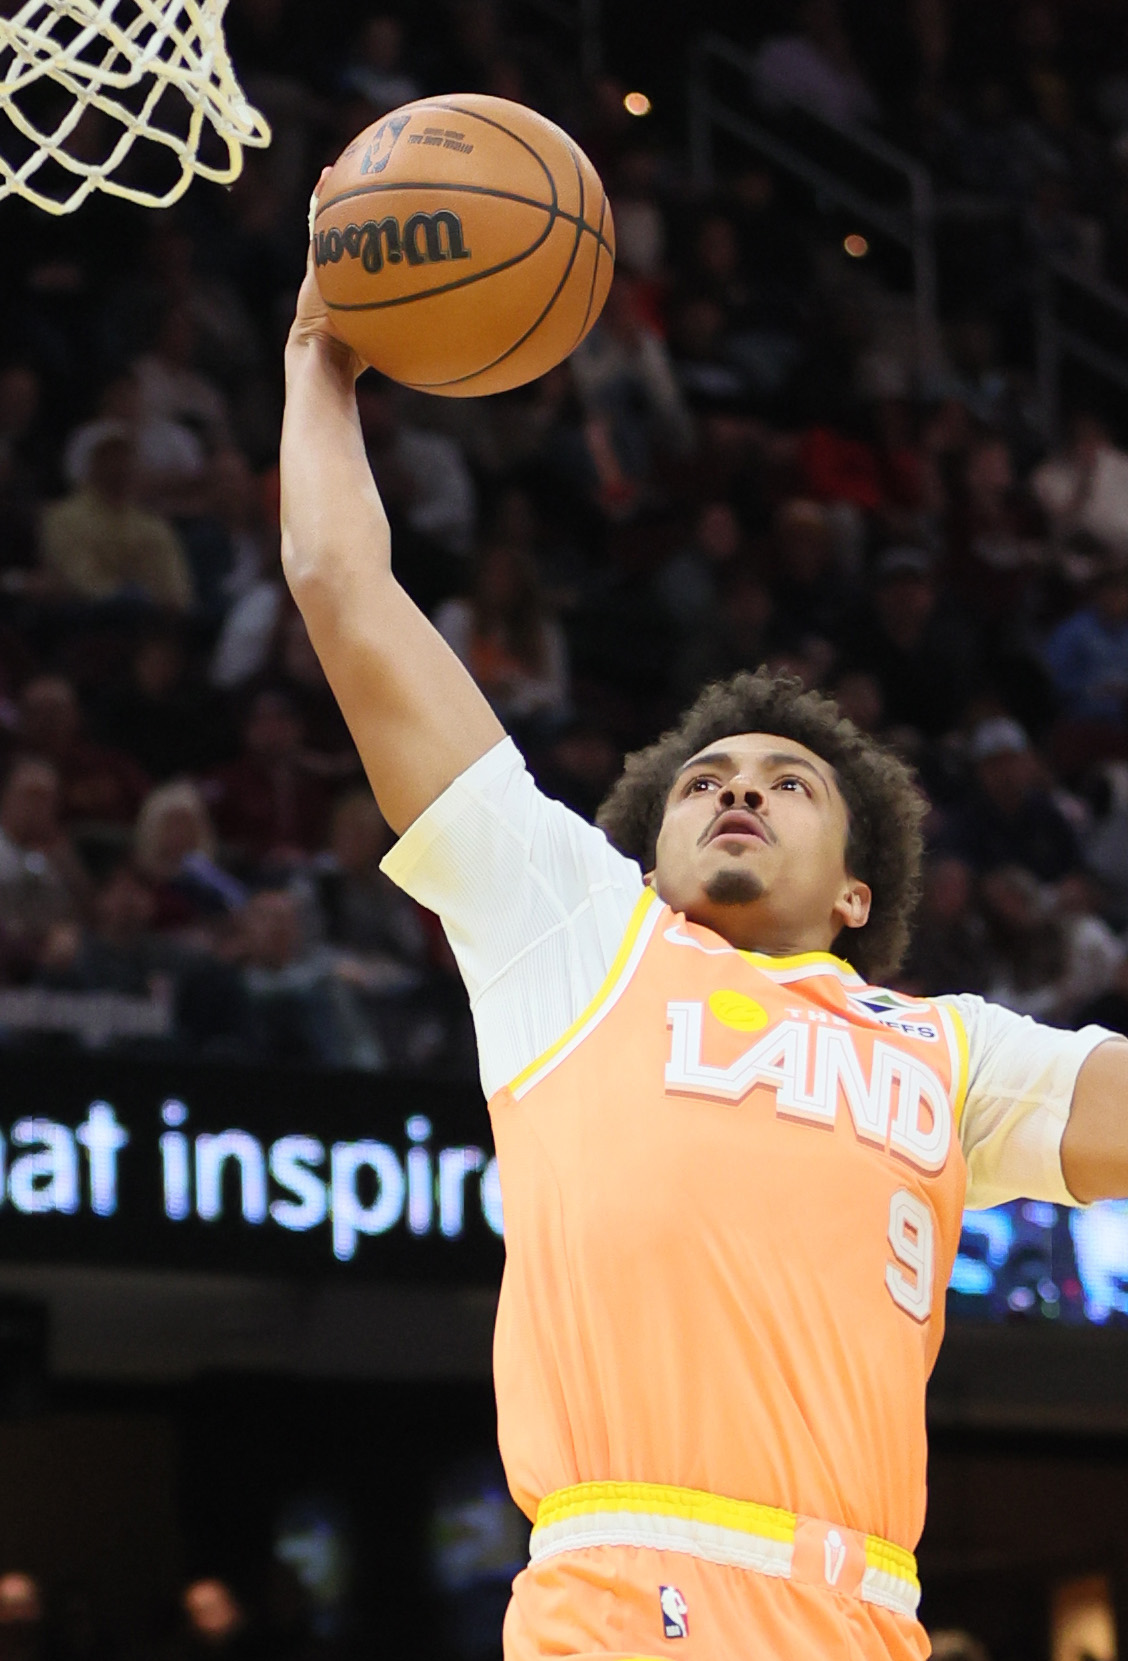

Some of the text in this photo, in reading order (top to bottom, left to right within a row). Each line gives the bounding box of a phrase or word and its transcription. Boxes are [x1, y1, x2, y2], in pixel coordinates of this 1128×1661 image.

[314, 208, 472, 274] Wilson
[664, 1001, 952, 1178] LAND
[0, 1100, 130, 1217] at
[884, 1186, 934, 1325] 9
